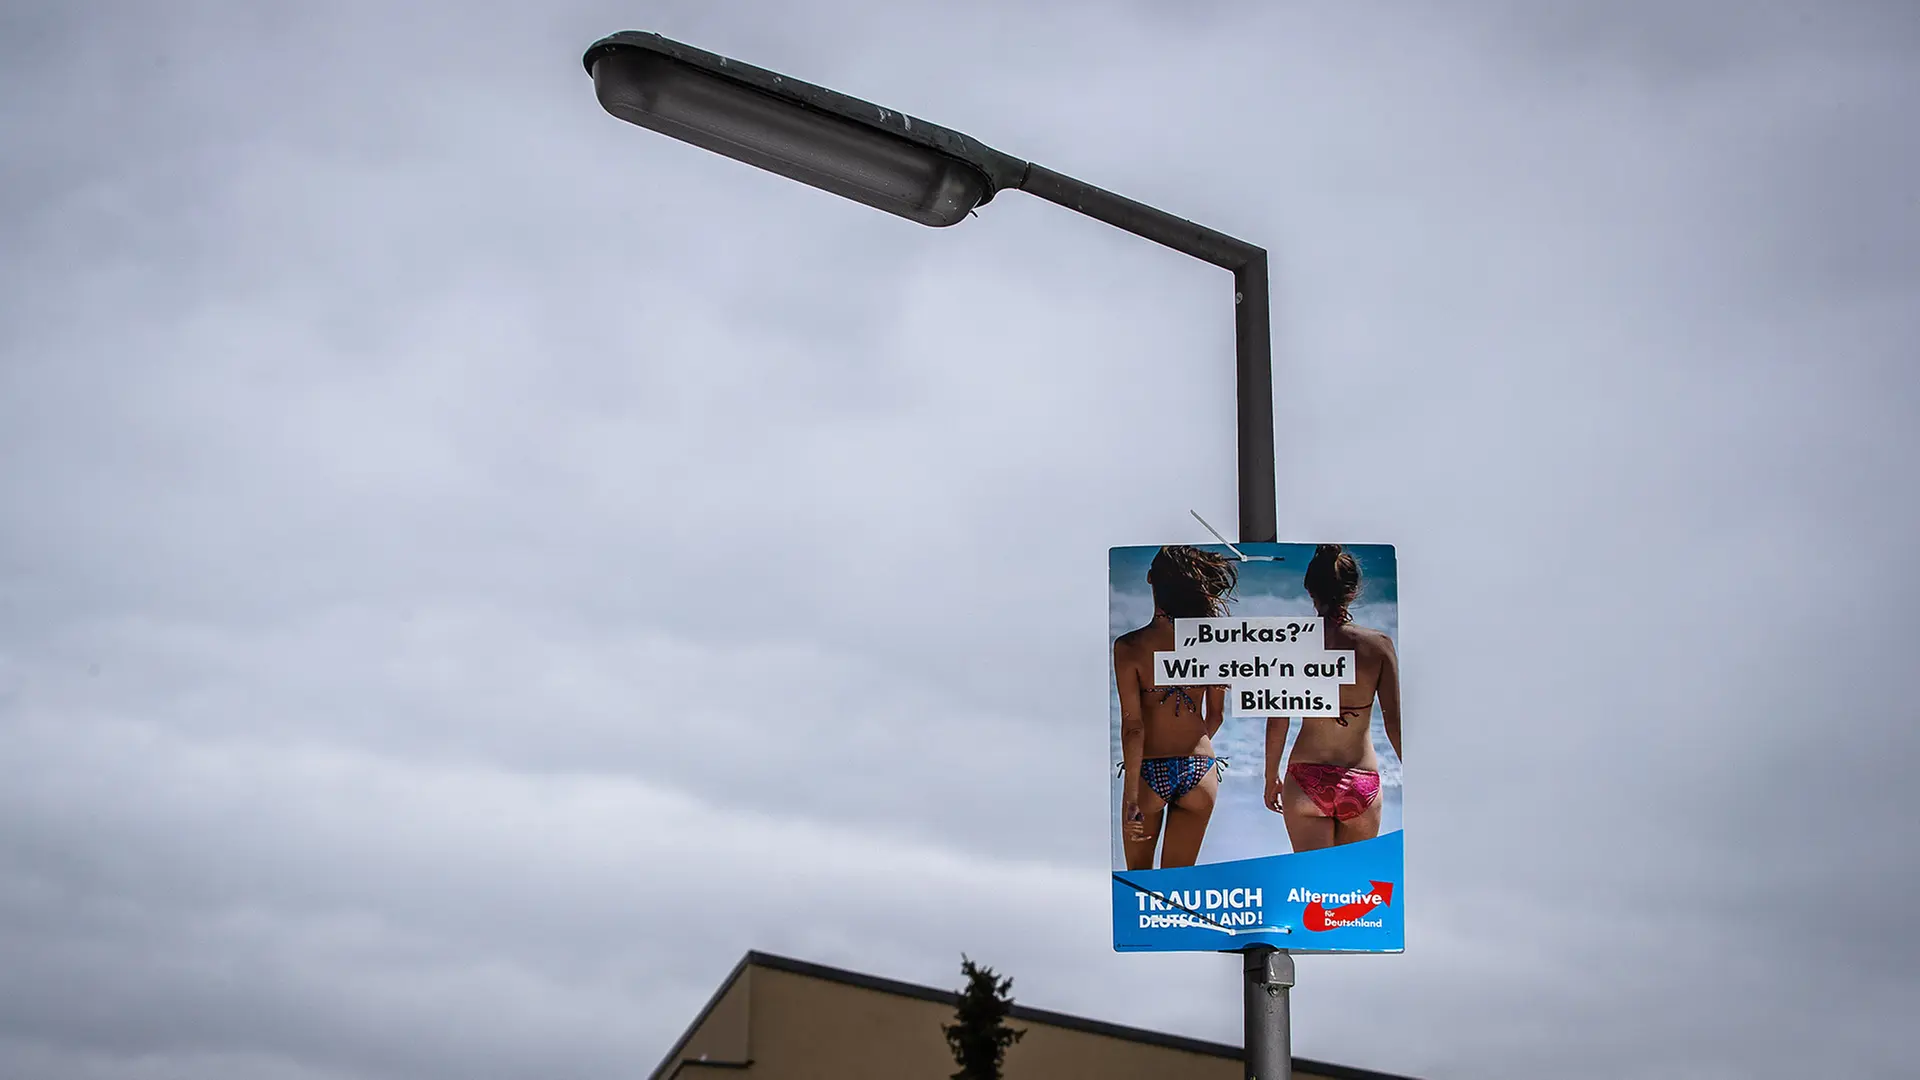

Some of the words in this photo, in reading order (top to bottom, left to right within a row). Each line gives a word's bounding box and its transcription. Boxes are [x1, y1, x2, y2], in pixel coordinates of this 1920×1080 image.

[1163, 658, 1209, 678] Wir
[1302, 656, 1346, 678] auf
[1240, 689, 1332, 711] Bikinis.
[1135, 890, 1201, 912] TRAU
[1205, 887, 1263, 910] DICH
[1287, 887, 1383, 905] Alternative
[1324, 910, 1335, 918] für
[1324, 918, 1383, 928] Deutschland
